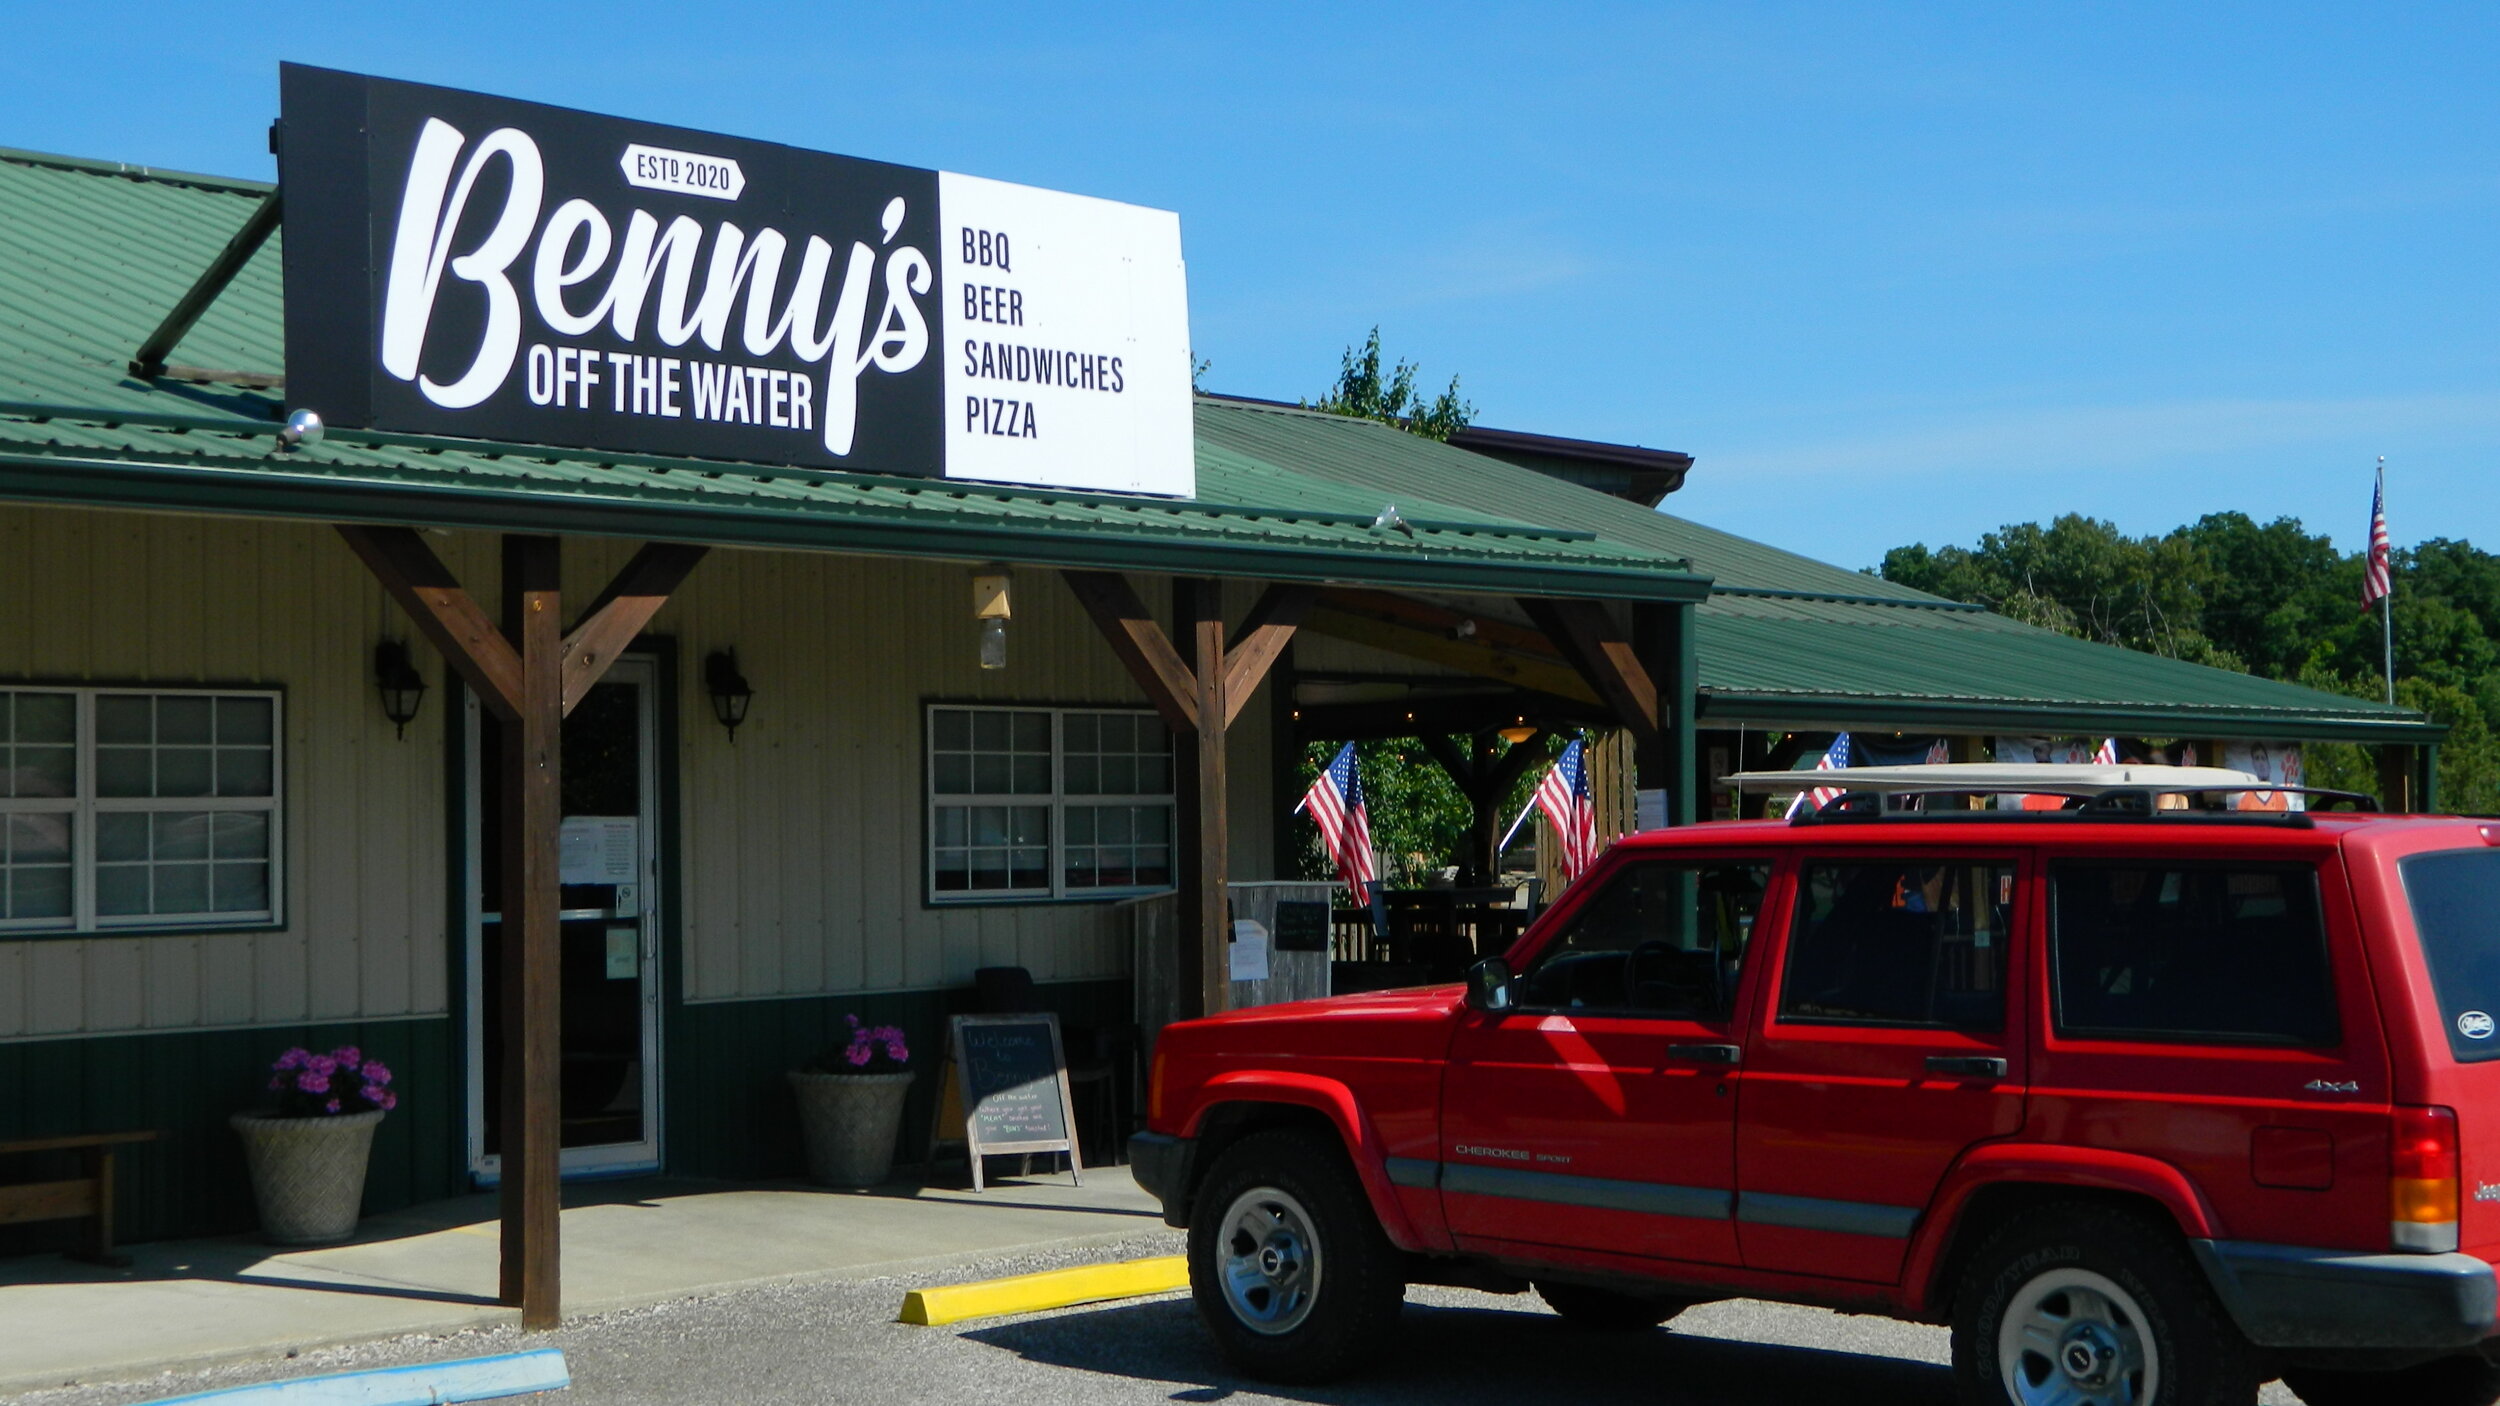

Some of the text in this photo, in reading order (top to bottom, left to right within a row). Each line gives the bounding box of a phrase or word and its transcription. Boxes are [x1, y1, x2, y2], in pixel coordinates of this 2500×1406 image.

[637, 153, 730, 190] ESTD 2020
[961, 226, 1011, 274] BBQ
[382, 117, 933, 456] Benny's
[963, 282, 1023, 327] BEER
[528, 343, 813, 430] OFF THE WATER
[964, 339, 1124, 393] SANDWICHES
[966, 395, 1037, 439] PIZZA
[967, 1030, 1035, 1048] Welcome
[992, 1093, 1005, 1103] Off
[1455, 1144, 1572, 1165] CHEROKEE SPORT
